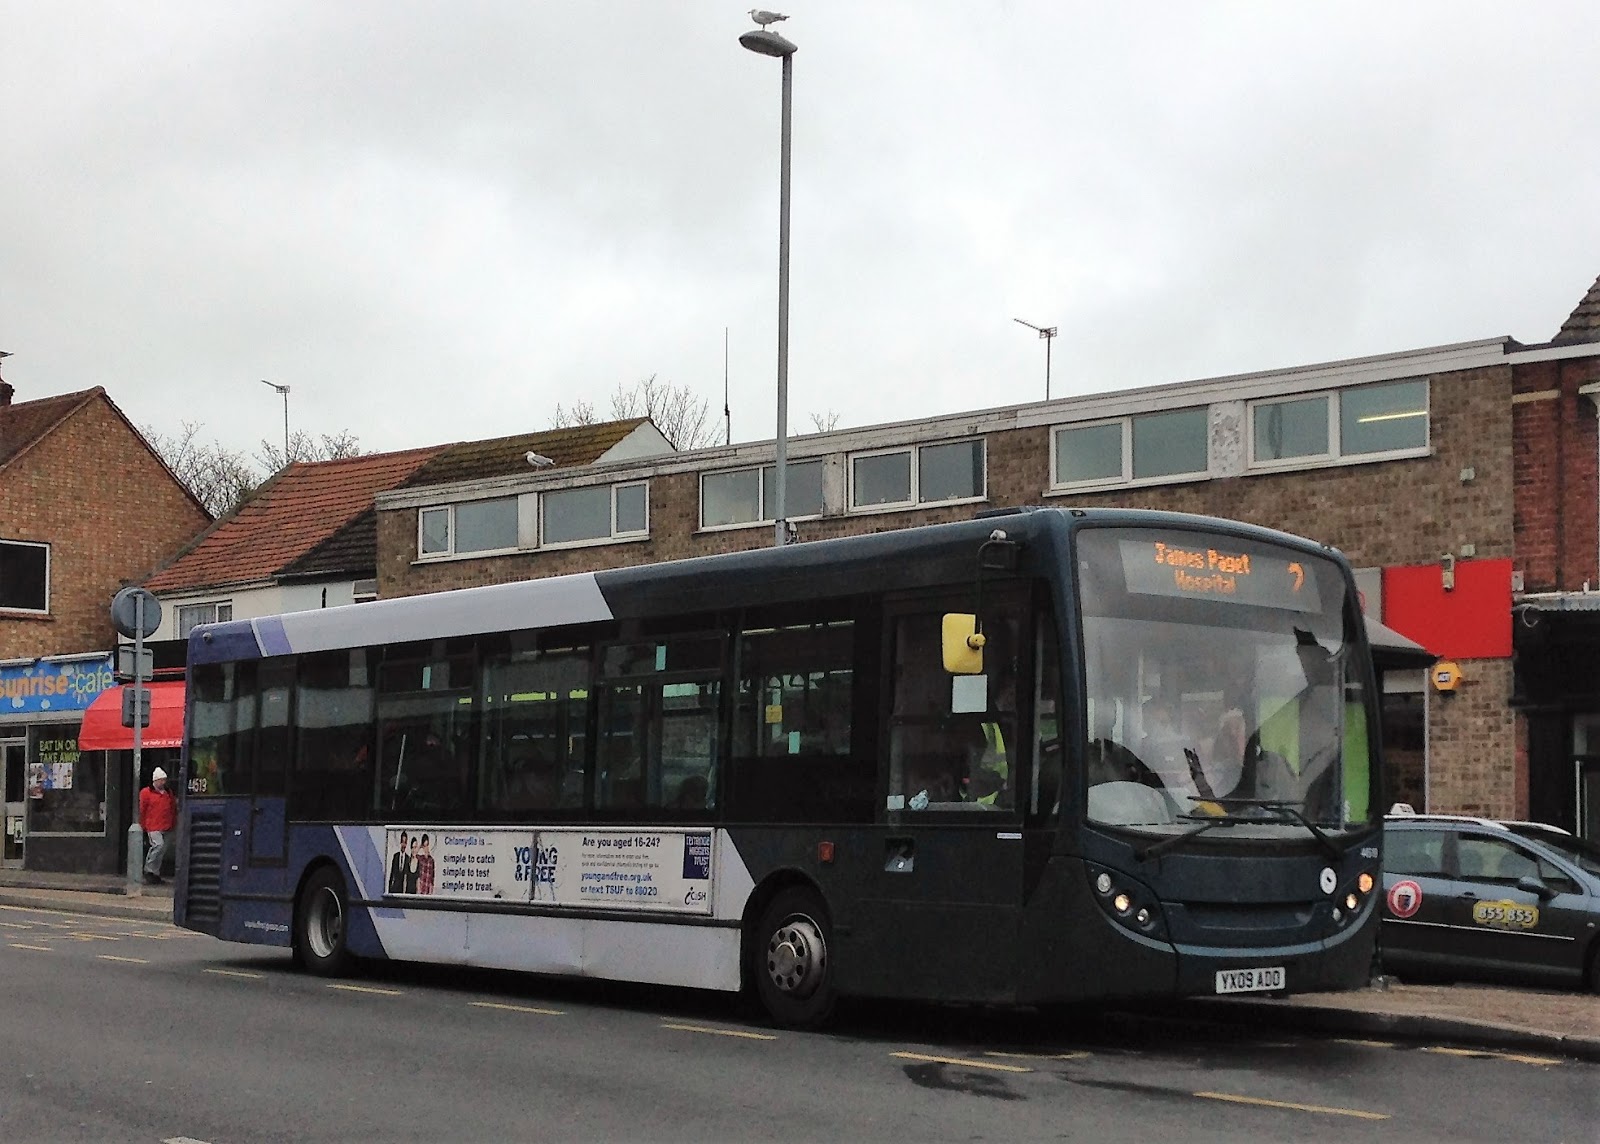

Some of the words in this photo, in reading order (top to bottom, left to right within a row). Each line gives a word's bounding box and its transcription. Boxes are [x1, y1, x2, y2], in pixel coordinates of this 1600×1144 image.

[39, 739, 54, 752] EAT
[65, 739, 77, 751] OR
[39, 751, 59, 763] TAKE
[59, 751, 81, 763] AWAY
[582, 837, 596, 847] Are
[597, 838, 612, 849] you
[612, 837, 633, 849] aged
[634, 836, 661, 848] 16-24?
[443, 854, 466, 865] simple
[468, 854, 475, 863] to
[476, 854, 496, 864] catch
[442, 867, 466, 878] simple
[467, 868, 475, 877] to
[476, 869, 490, 878] test
[514, 864, 523, 882] &
[441, 880, 465, 892] simple
[466, 882, 474, 891] to
[580, 885, 588, 893] or
[588, 885, 604, 894] text
[605, 885, 625, 895] TSUF
[625, 887, 634, 895] to
[1221, 971, 1254, 990] YX09
